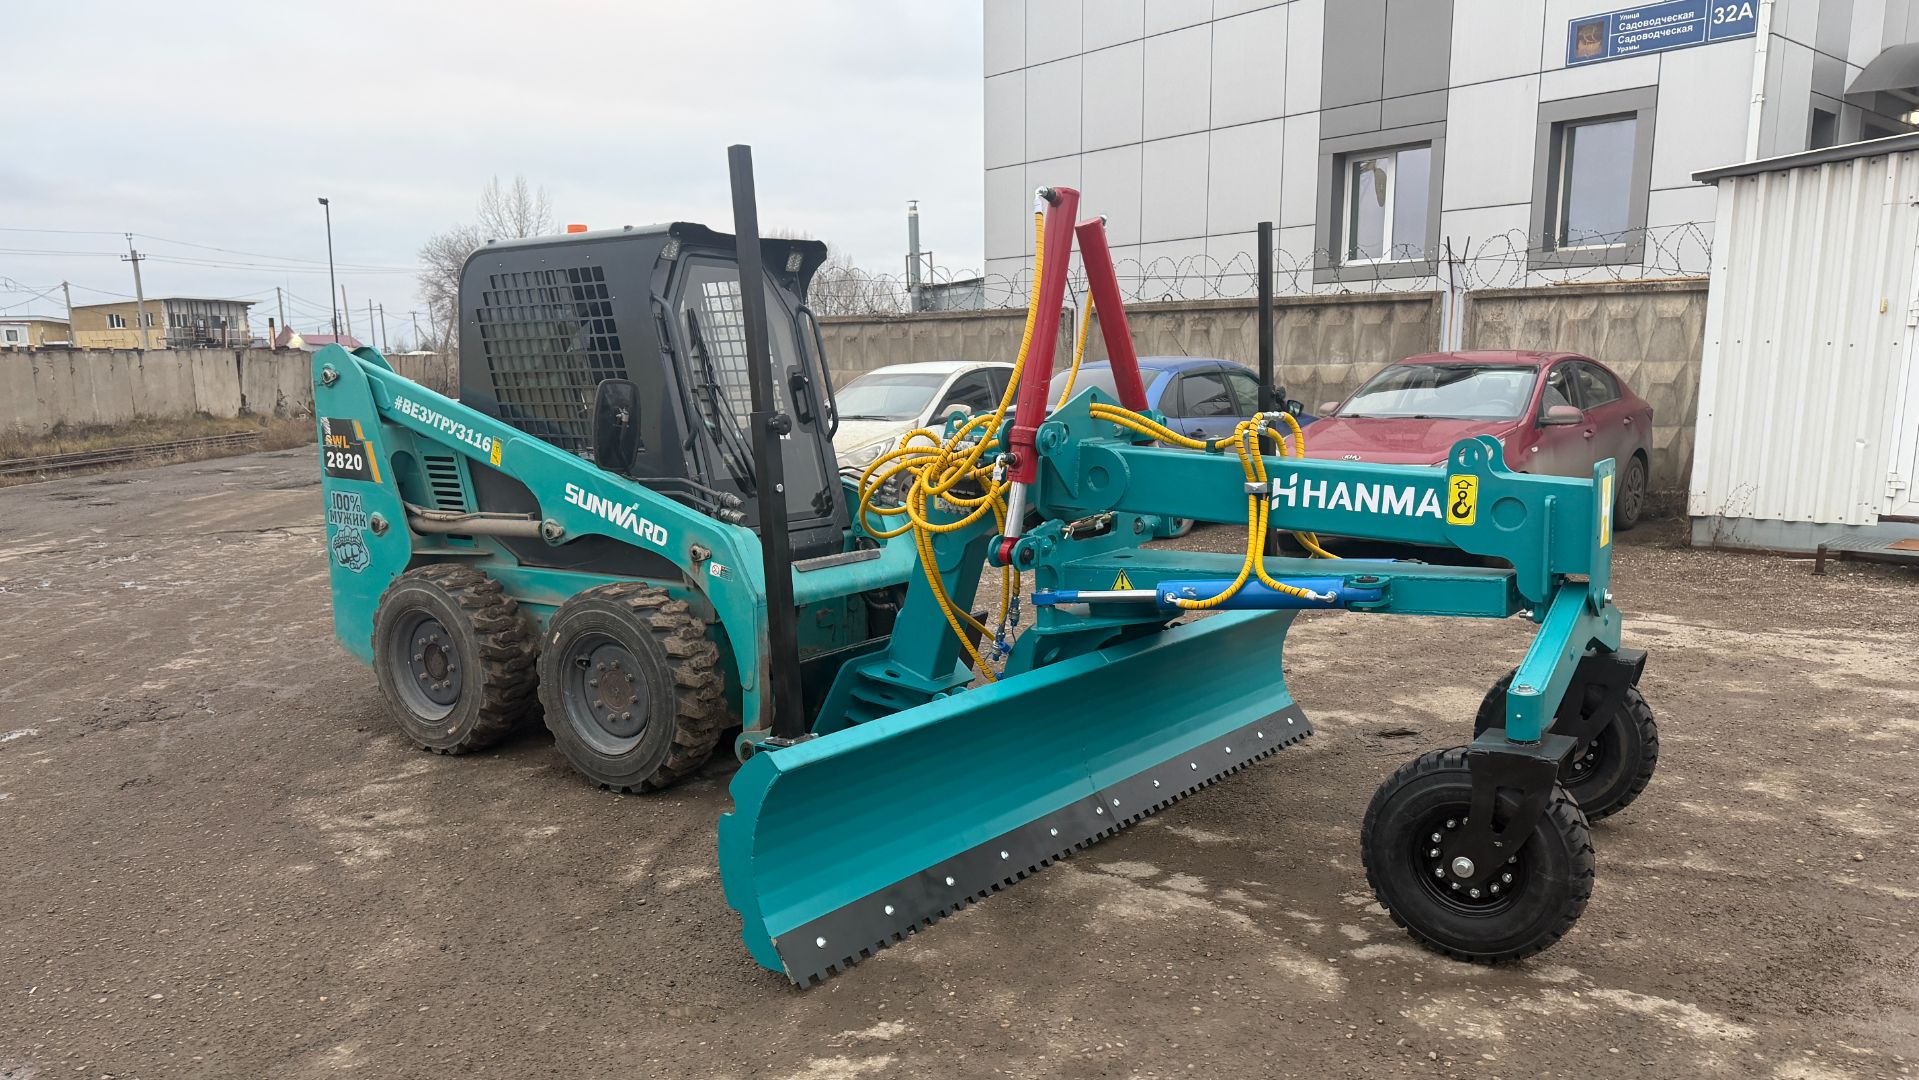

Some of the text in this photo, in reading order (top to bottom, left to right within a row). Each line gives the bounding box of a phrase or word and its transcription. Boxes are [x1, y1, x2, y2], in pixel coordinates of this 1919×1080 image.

[1618, 11, 1695, 31] Садоводческая
[1619, 12, 1640, 21] Улица
[1617, 25, 1694, 44] Садоводческая
[1616, 44, 1640, 53] Урамы
[326, 451, 363, 471] 2820
[332, 492, 361, 513] 100%
[329, 510, 367, 528] МУЖИК
[564, 482, 668, 547] SUNWARD
